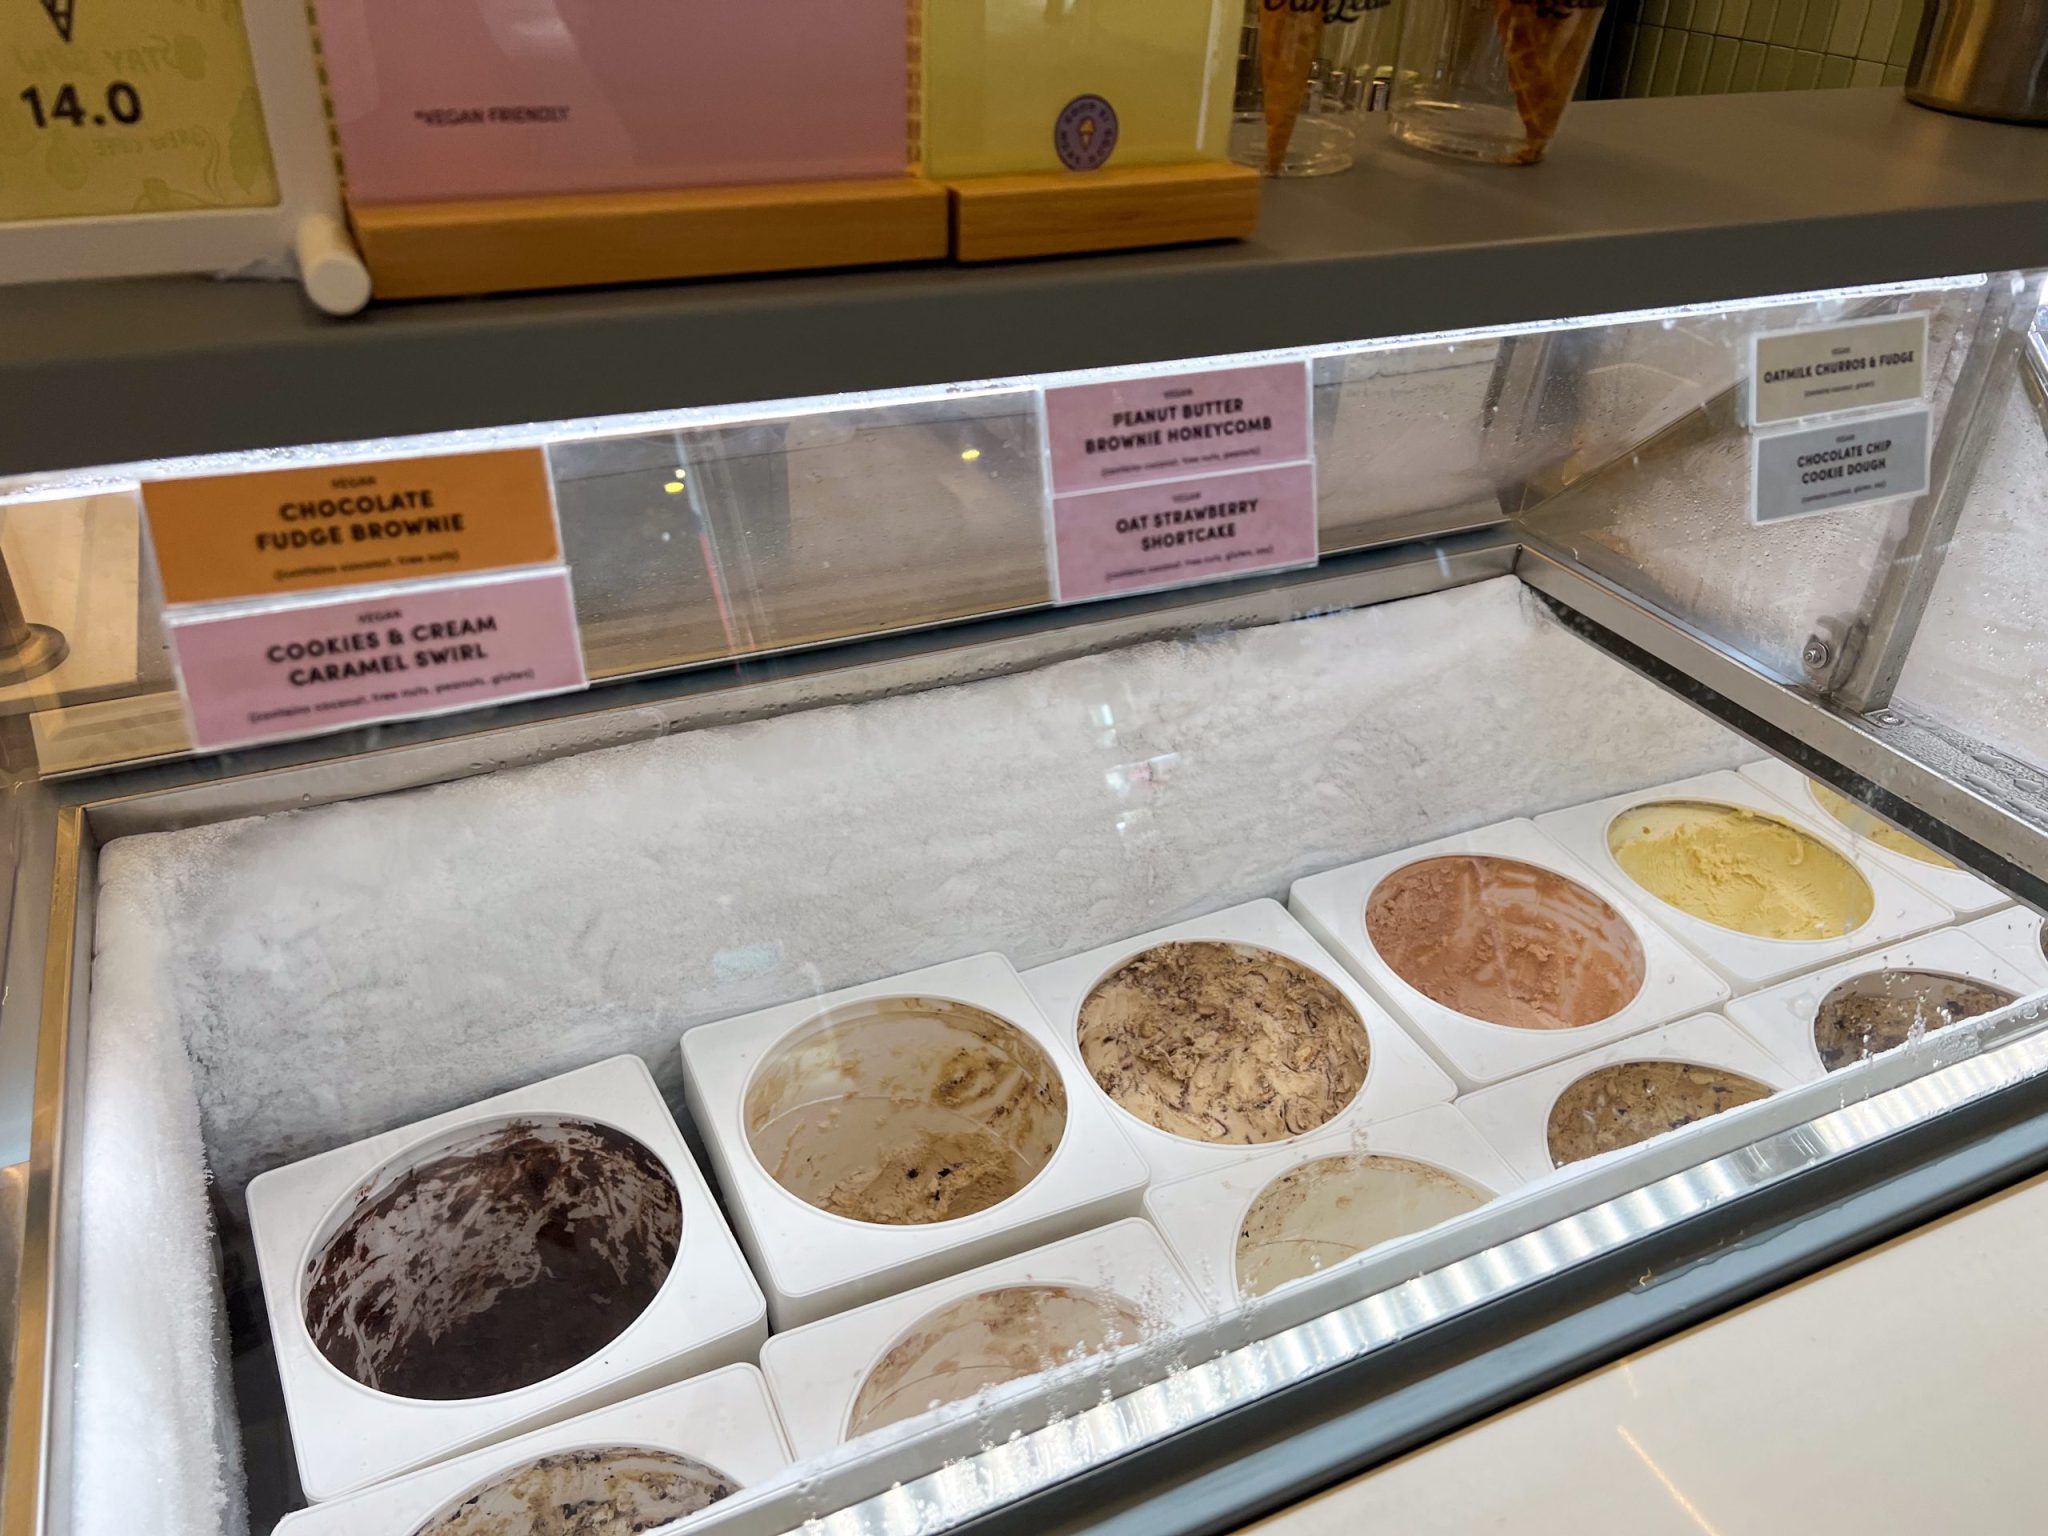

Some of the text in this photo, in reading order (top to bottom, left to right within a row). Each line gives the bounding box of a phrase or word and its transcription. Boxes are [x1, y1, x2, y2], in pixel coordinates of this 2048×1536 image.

[20, 81, 143, 128] 14.0
[1816, 358, 1866, 376] CHURROS
[1869, 356, 1876, 368] &
[1879, 350, 1914, 366] FUDGE
[1113, 398, 1243, 428] PEANUT BUTTER
[1085, 416, 1272, 454] BROWNIE HONEYCOMB
[1797, 440, 1892, 468] CHOCOLATE CHIP
[331, 475, 376, 489] VEGAN
[1801, 458, 1886, 484] COOKIE DOUGH
[279, 490, 434, 523] CHOCOLATE
[1116, 498, 1259, 534] OAT STRAWBERRY
[256, 513, 465, 552] FUDGE BROWNIE
[1141, 523, 1236, 551] SHORTCAKE
[357, 609, 404, 625] VEGAN
[266, 615, 497, 663] COOKIES & CREAM
[289, 643, 487, 687] CARAMEL SWIRL
